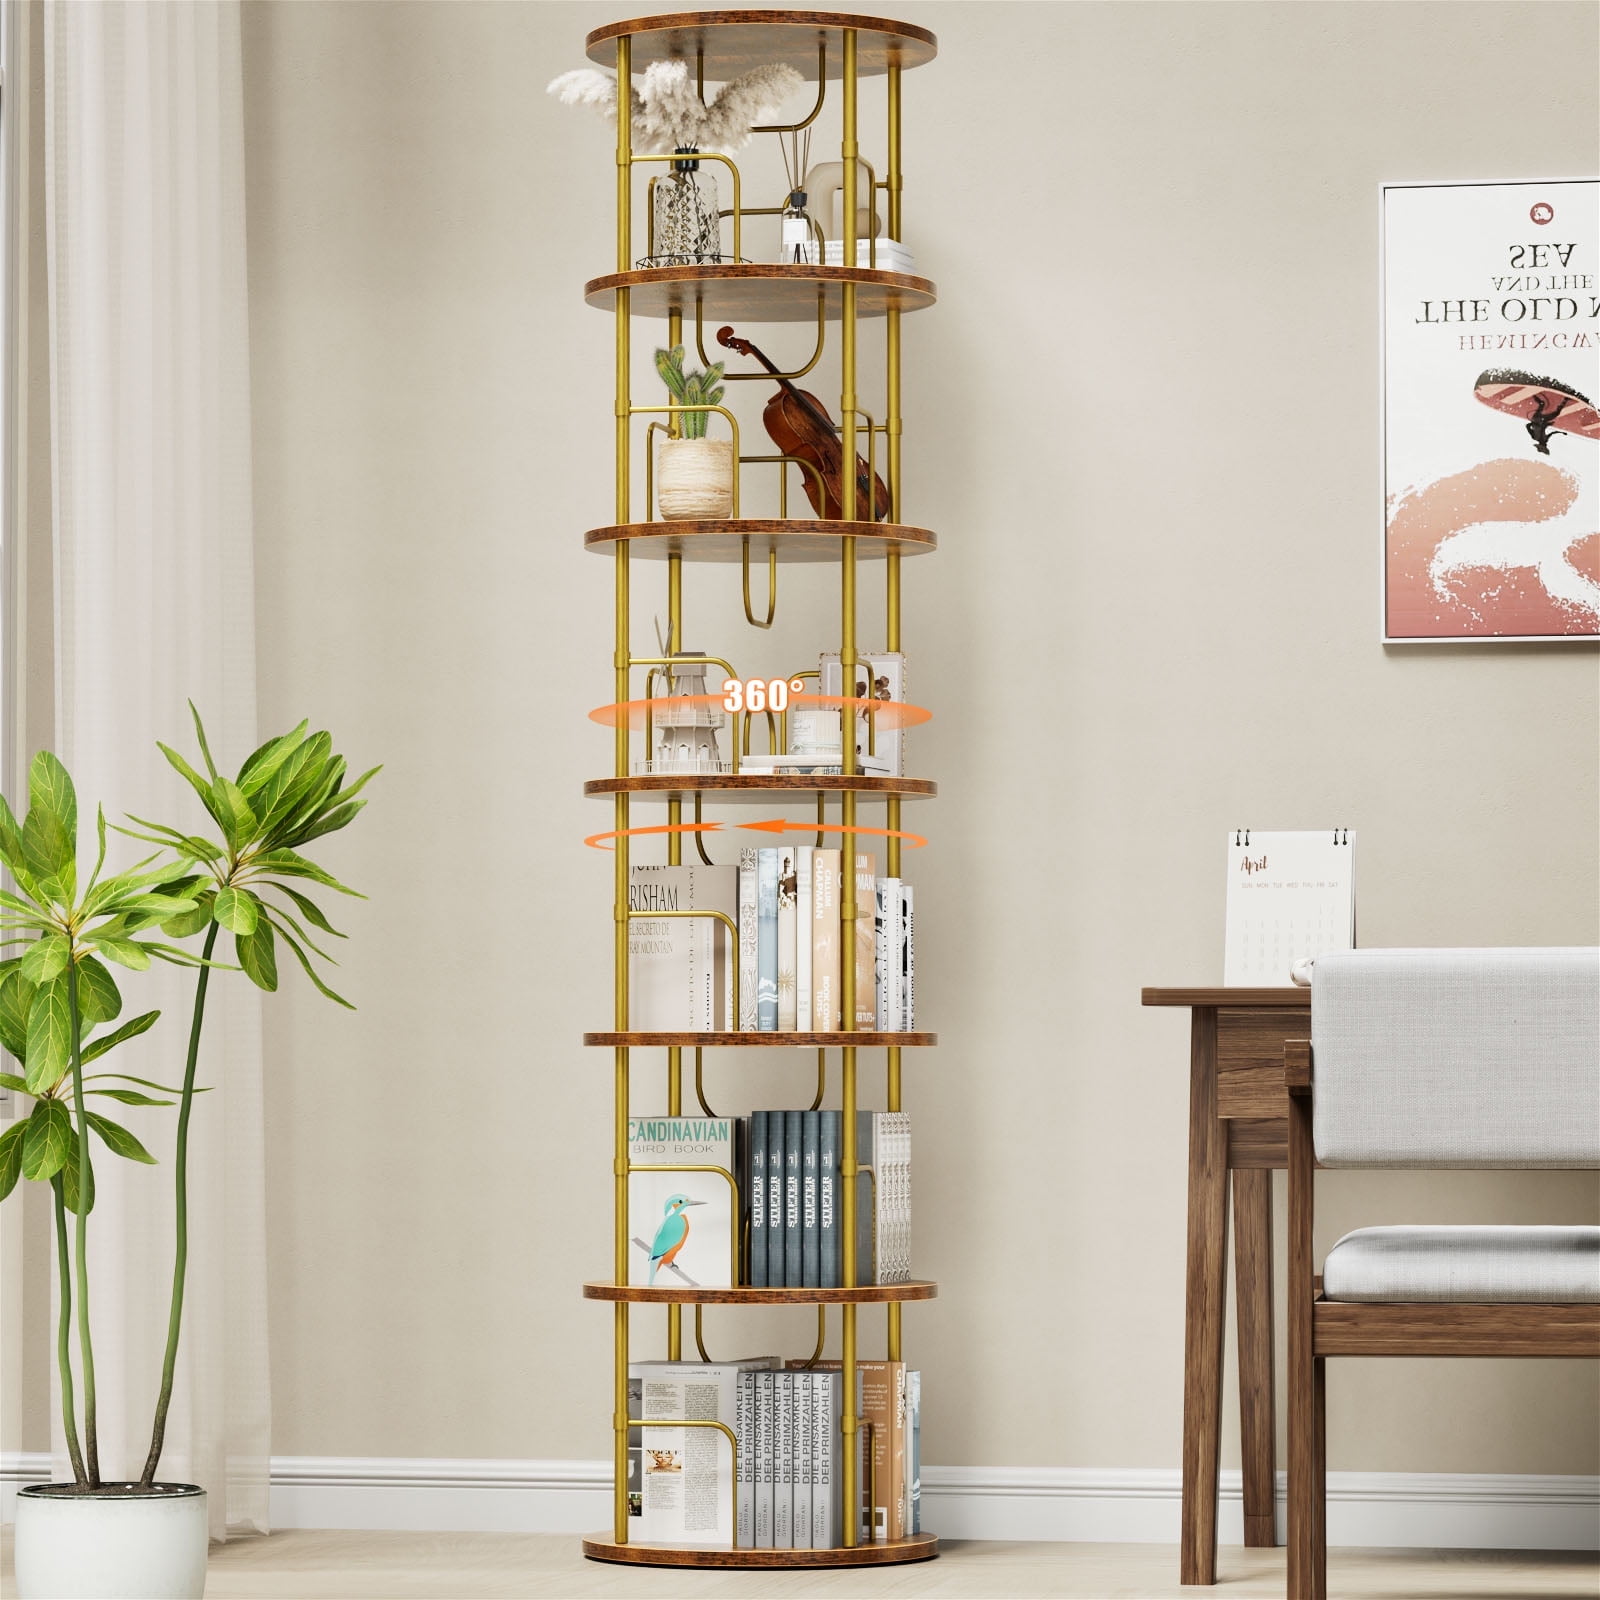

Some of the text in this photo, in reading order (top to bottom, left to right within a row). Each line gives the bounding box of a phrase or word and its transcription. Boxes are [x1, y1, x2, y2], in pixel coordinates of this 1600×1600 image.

[1241, 855, 1268, 876] April
[636, 922, 661, 936] SECRETO
[641, 940, 673, 954] MOUNTAIN
[633, 1144, 714, 1154] BIRD BOOK
